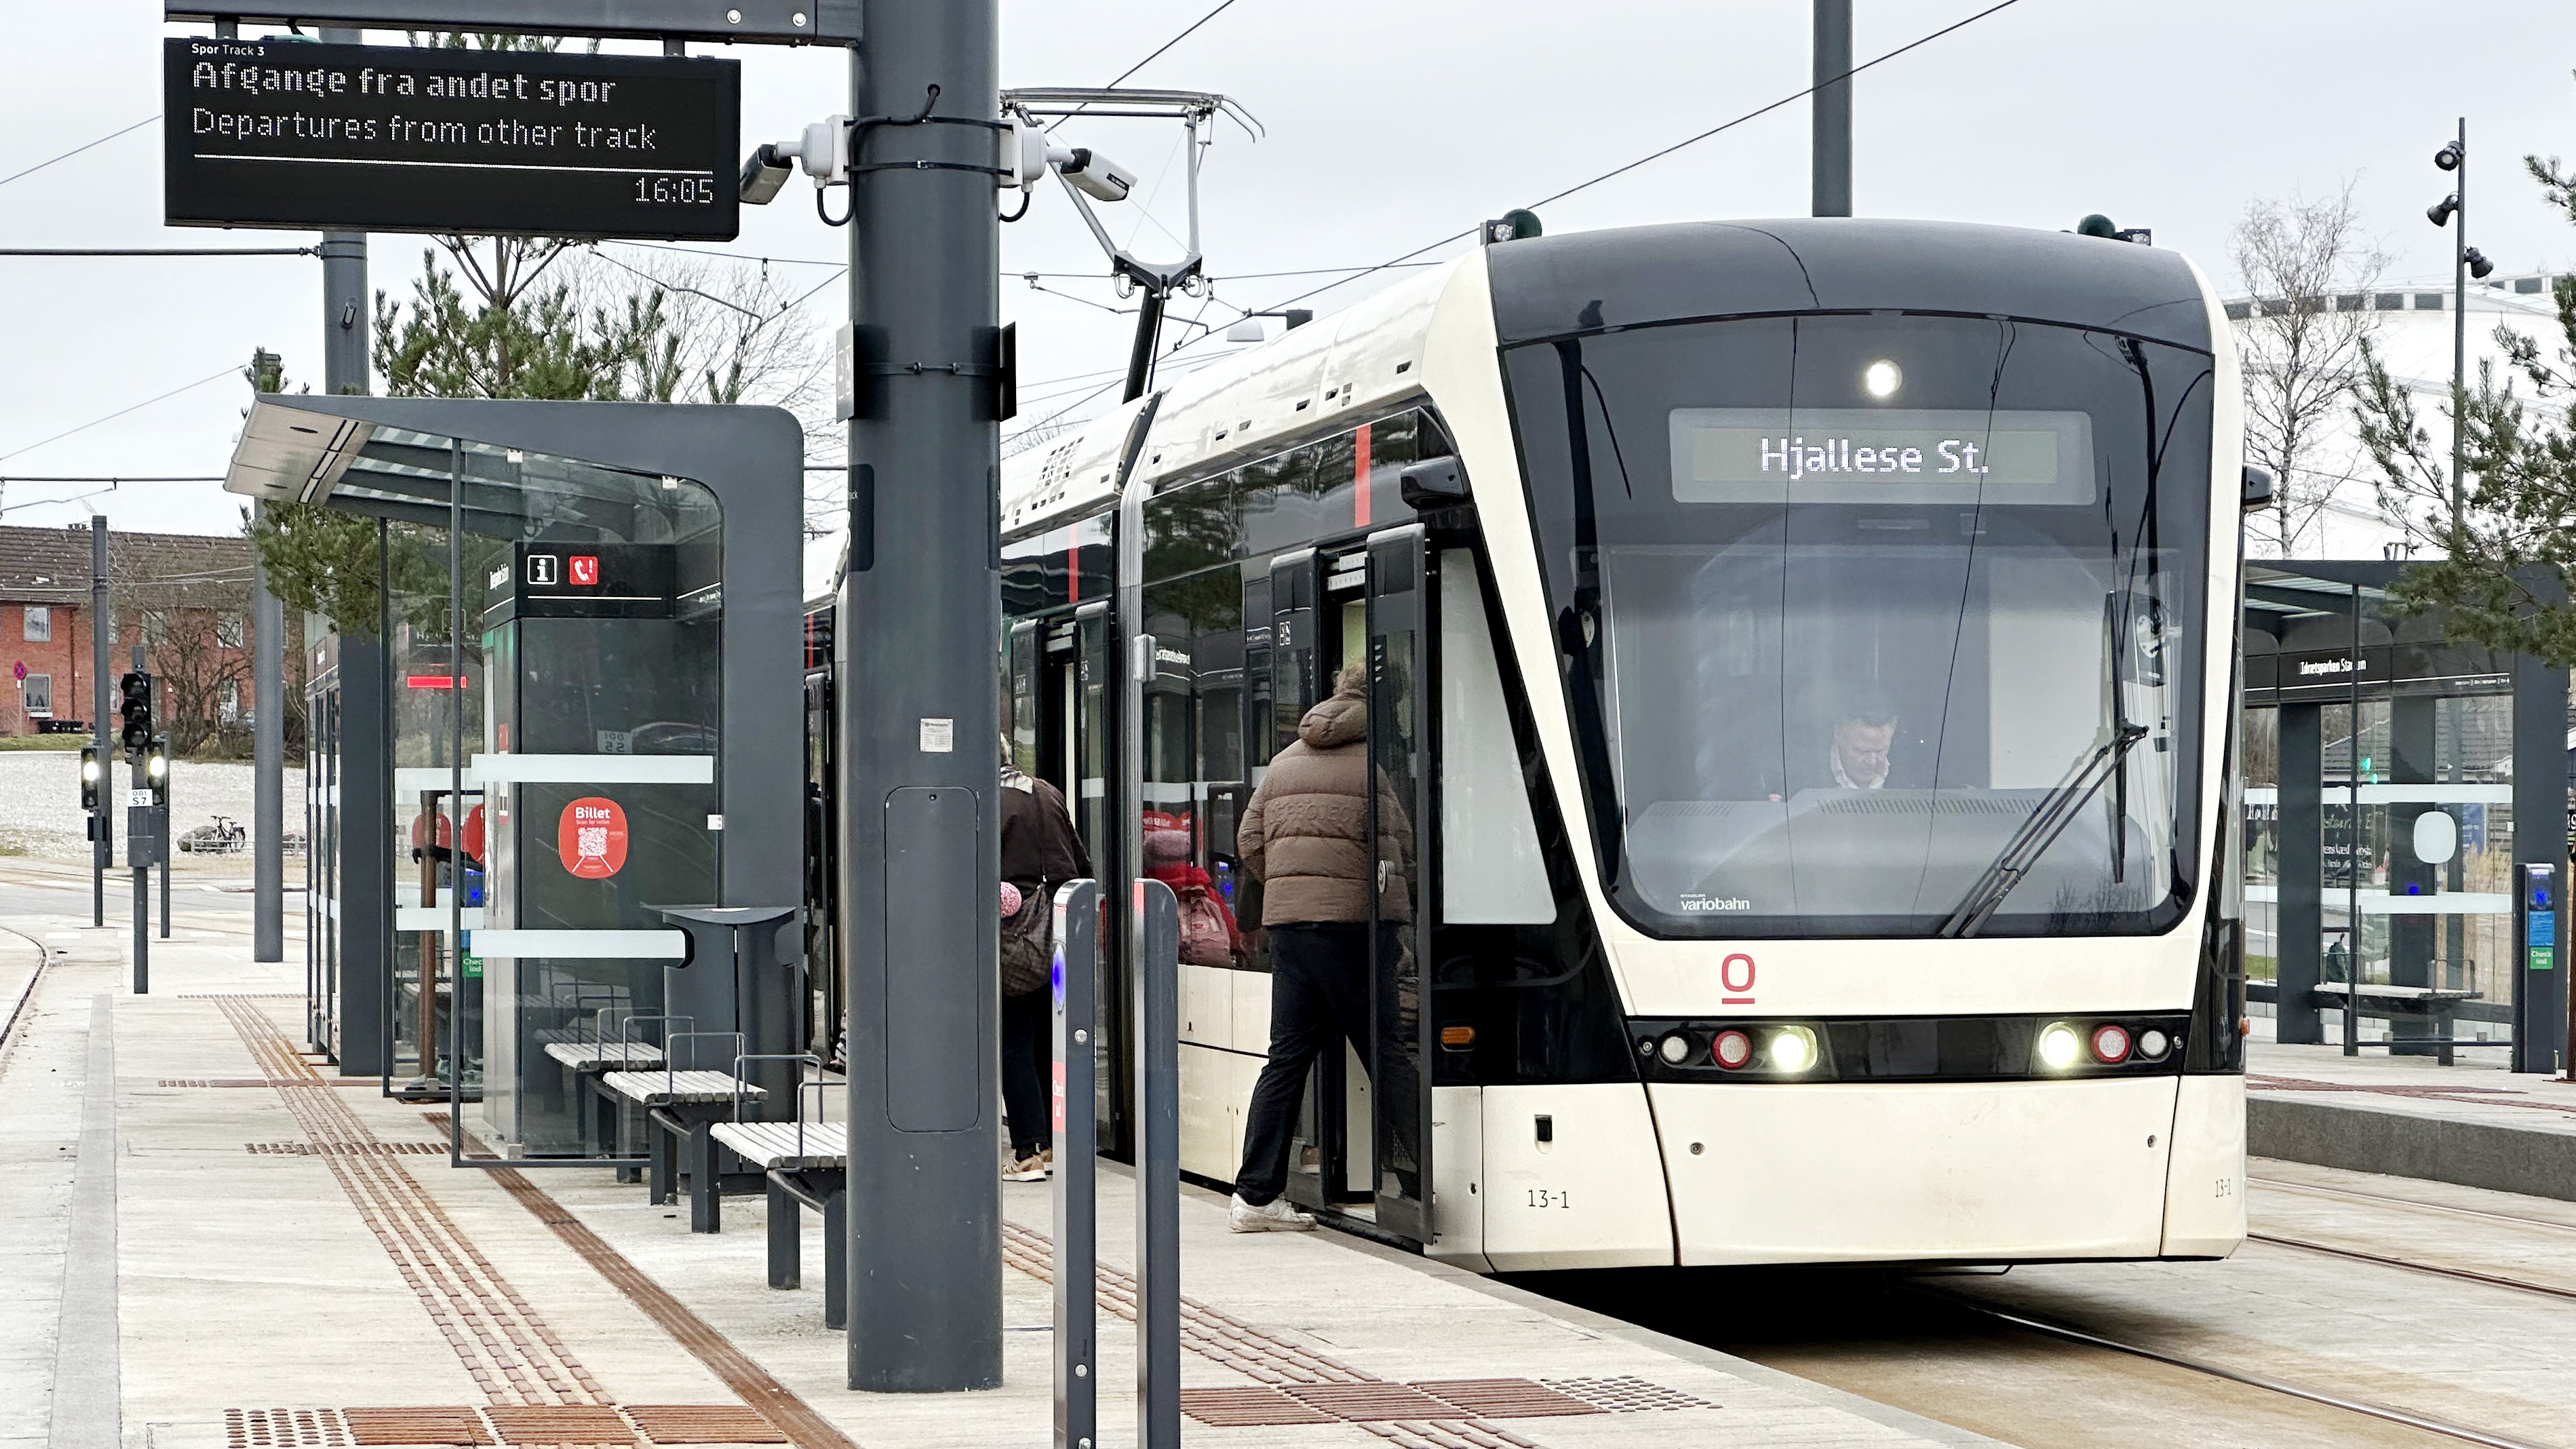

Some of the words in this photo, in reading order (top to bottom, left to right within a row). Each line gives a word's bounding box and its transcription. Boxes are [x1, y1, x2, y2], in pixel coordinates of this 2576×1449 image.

[191, 43, 219, 56] Spor
[222, 44, 254, 56] Track
[257, 46, 265, 56] 3
[193, 62, 346, 98] Afgange
[358, 68, 414, 96] fra
[427, 72, 528, 100] andet
[540, 79, 616, 107] spor
[193, 107, 376, 140] Departures
[389, 115, 466, 143] from
[478, 119, 562, 146] other
[574, 121, 656, 150] track
[636, 177, 714, 204] 16:05
[1761, 438, 1924, 480] Hjallese
[1938, 440, 1989, 474] St.
[575, 806, 610, 819] Billet
[1680, 897, 1750, 910] variobahn
[463, 957, 483, 965] Chec
[2215, 1178, 2231, 1198] 13-1
[1528, 1189, 1569, 1209] 13-1
